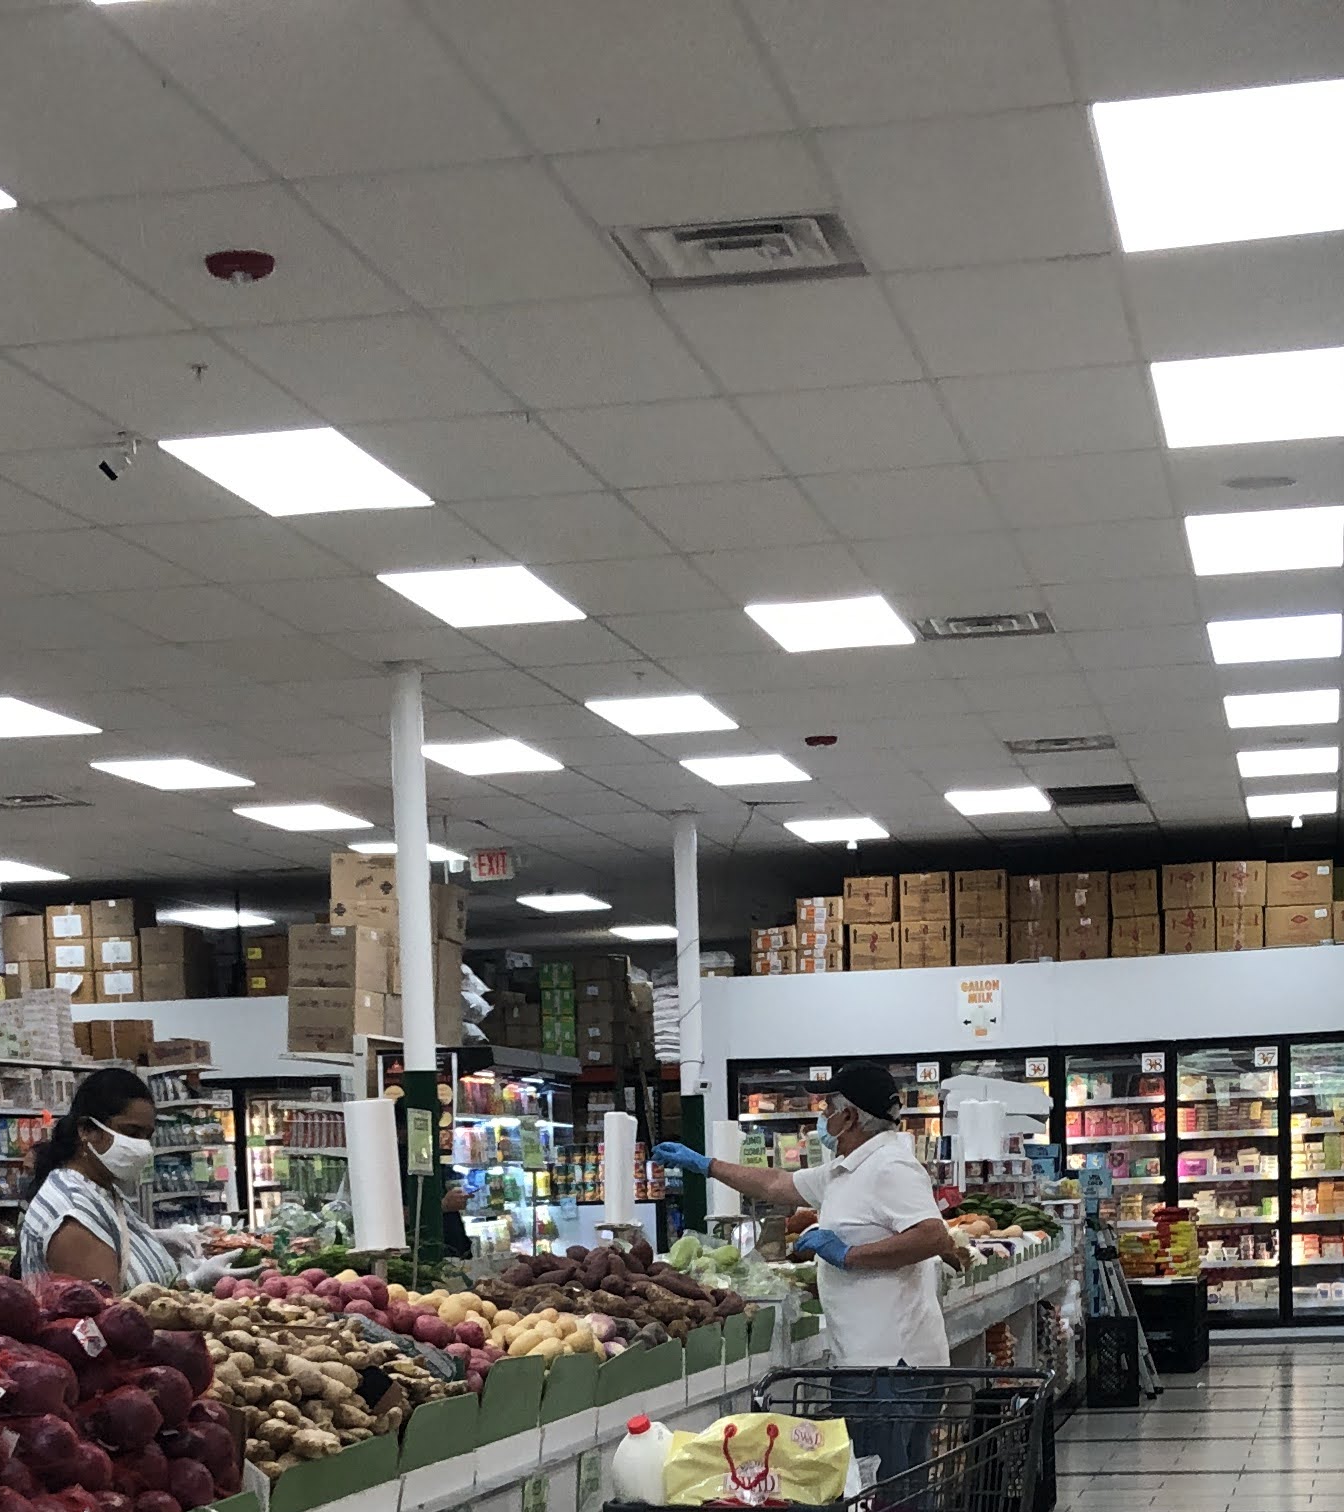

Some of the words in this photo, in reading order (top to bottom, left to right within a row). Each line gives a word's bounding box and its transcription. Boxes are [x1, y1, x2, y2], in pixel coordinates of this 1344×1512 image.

[477, 851, 508, 878] EXIT
[960, 979, 1000, 993] GALLON
[967, 992, 994, 1004] MILK
[1144, 1056, 1163, 1072] 38
[1257, 1051, 1276, 1066] 37
[919, 1068, 938, 1081] 40
[1028, 1062, 1046, 1077] 39
